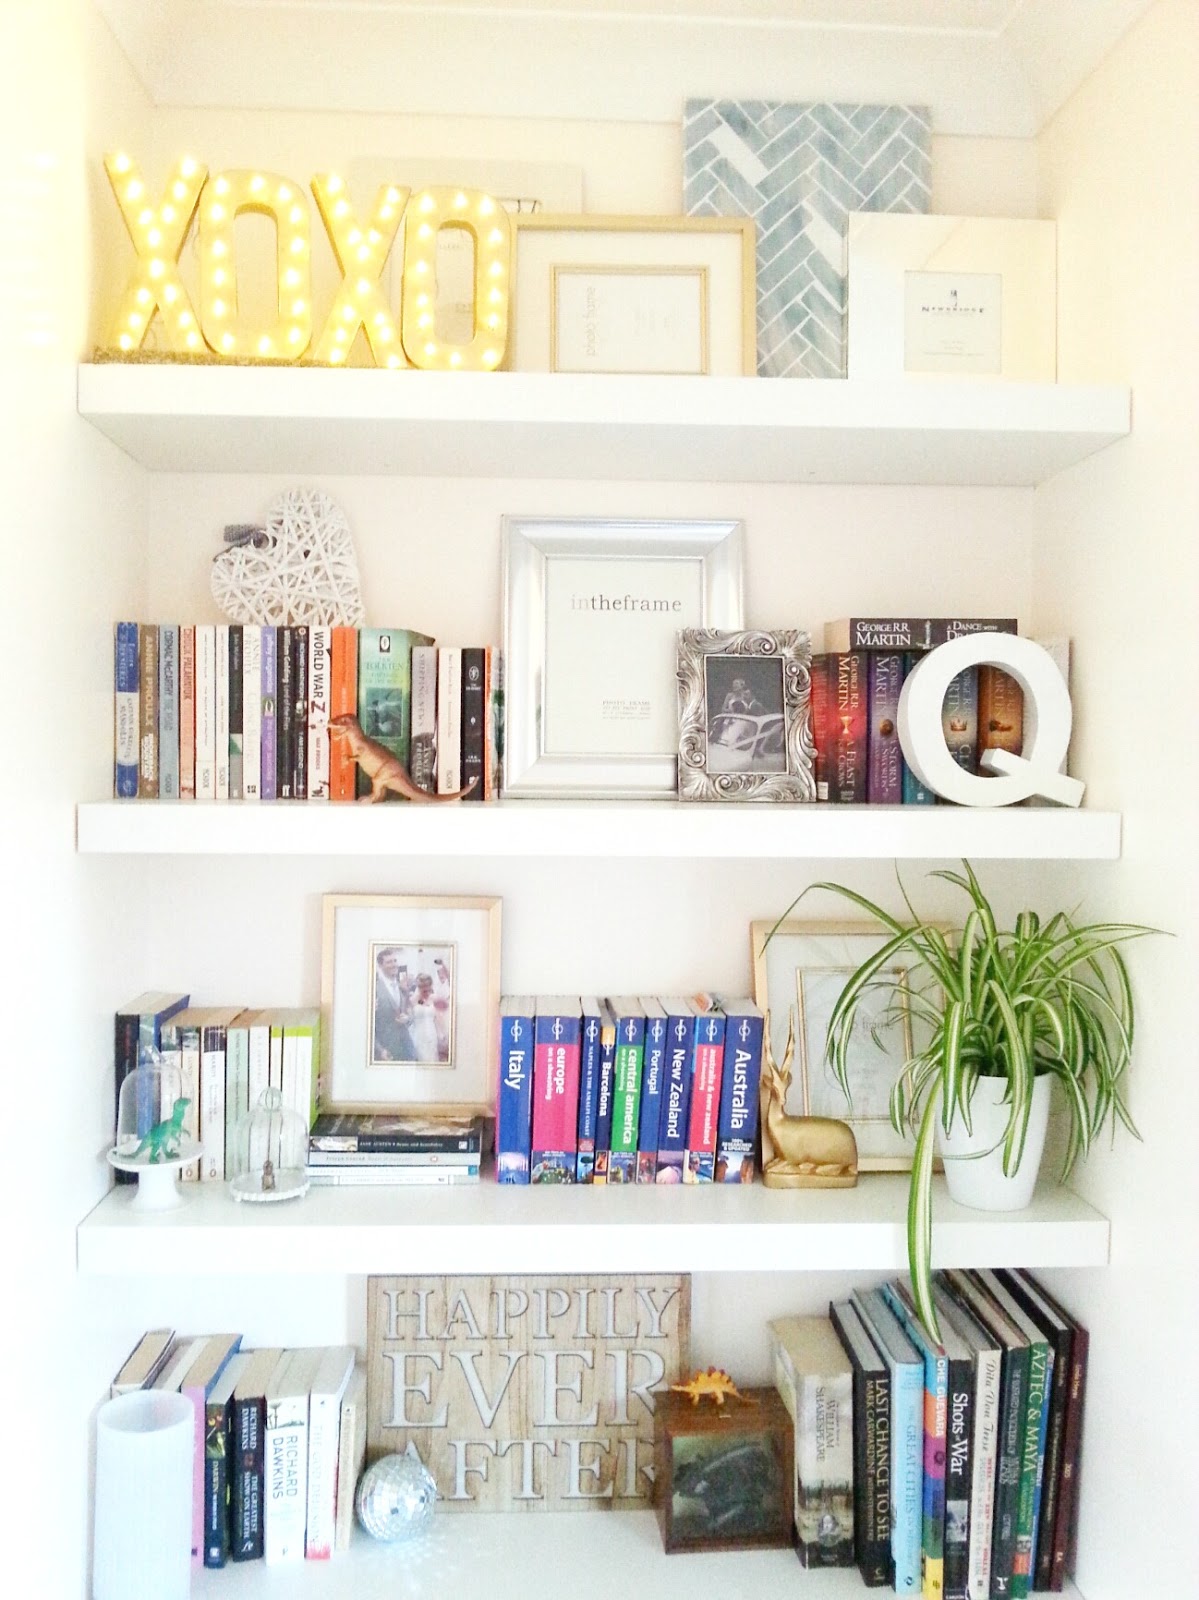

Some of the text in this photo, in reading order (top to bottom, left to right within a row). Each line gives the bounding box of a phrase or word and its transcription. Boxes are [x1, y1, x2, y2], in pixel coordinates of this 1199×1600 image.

[103, 152, 511, 372] XOXO
[163, 630, 174, 659] CORMAC
[856, 621, 892, 633] GEORGE
[856, 632, 911, 646] MARTIN
[953, 621, 982, 631] DANCE
[145, 635, 154, 727] ANNIE PROULX
[281, 657, 290, 683] Golding
[311, 632, 326, 715] WORLD WAR Z
[838, 655, 851, 711] MARTIN
[948, 676, 960, 718] ARTIN
[897, 632, 1085, 808] Q
[846, 750, 857, 787] FEAST
[504, 1049, 526, 1090] Italy
[553, 1047, 567, 1095] europe
[599, 1061, 612, 1117] Barcelona
[625, 1049, 638, 1092] central
[648, 1049, 661, 1095] Portugal
[707, 1049, 717, 1085] australia
[730, 1048, 752, 1129] Australia
[667, 1049, 686, 1139] New Zealand
[705, 1094, 713, 1111] new
[622, 1094, 635, 1145] america
[703, 1112, 712, 1145] zealand
[383, 1287, 681, 1341] HAPPILY
[382, 1349, 666, 1429] EVER
[866, 1379, 875, 1409] MARK
[983, 1358, 998, 1388] Dita
[1029, 1348, 1047, 1404] AZTEC
[934, 1359, 946, 1437] CHE GUEVARA
[951, 1392, 969, 1434] Shots
[982, 1390, 998, 1418] Von
[1027, 1408, 1042, 1421] &
[241, 1407, 250, 1450] DAWKINS
[249, 1406, 258, 1450] RICHARD
[815, 1386, 827, 1463] SHAKESPEARE
[825, 1400, 837, 1449] WILLIAM
[866, 1410, 875, 1475] CARWARDINE
[905, 1423, 918, 1467] GREAT
[981, 1423, 996, 1451] Teese
[272, 1436, 285, 1500] DAWKINS
[285, 1434, 299, 1498] RICHARD
[403, 1438, 657, 1501] FTER
[876, 1379, 889, 1542] LAST CHANCE TO SEE
[950, 1438, 968, 1476] War
[1023, 1426, 1041, 1473] MAYA
[250, 1492, 258, 1533] GREATEST
[904, 1469, 917, 1514] CITIES
